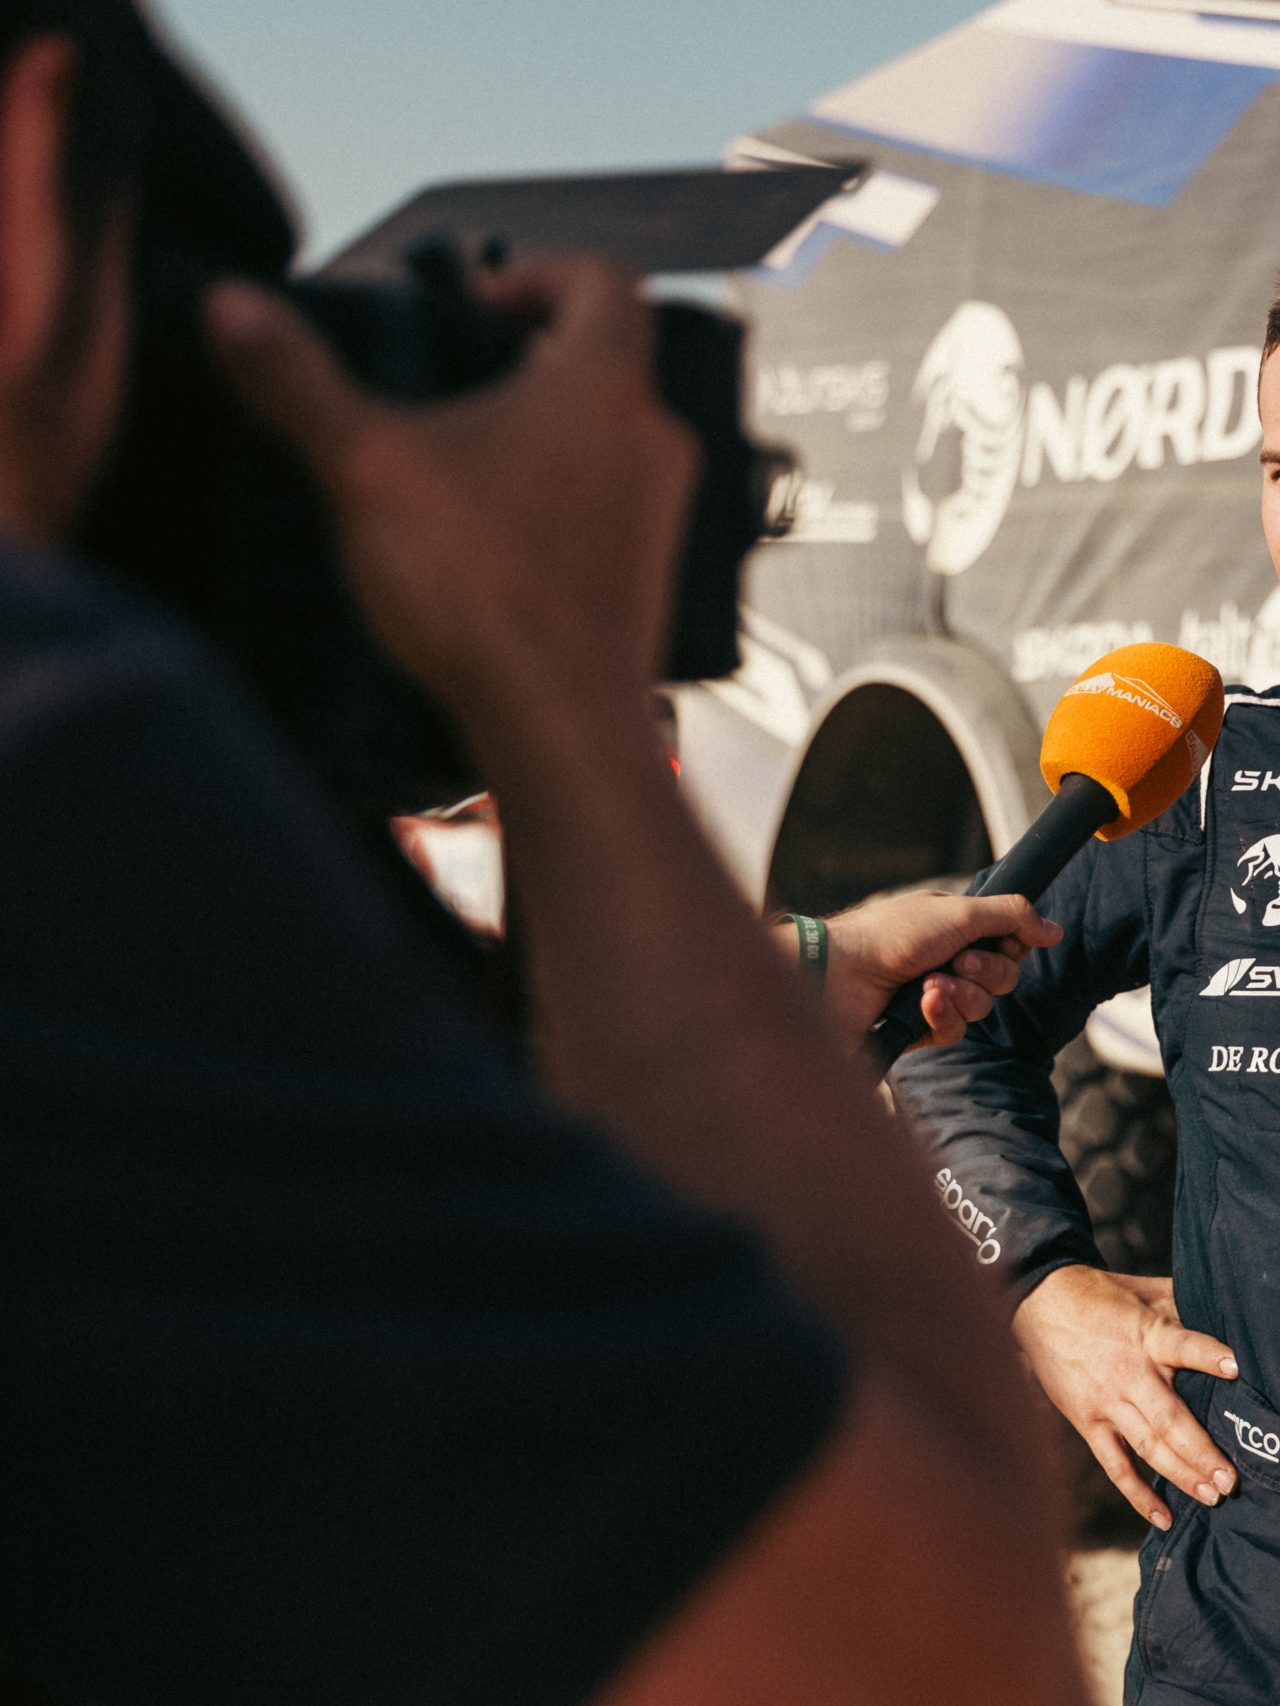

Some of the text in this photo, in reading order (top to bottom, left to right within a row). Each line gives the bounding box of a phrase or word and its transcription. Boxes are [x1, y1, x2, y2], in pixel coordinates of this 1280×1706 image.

[1021, 345, 1263, 487] NØRD
[1106, 687, 1184, 729] MANIACS
[1208, 1046, 1244, 1072] DE
